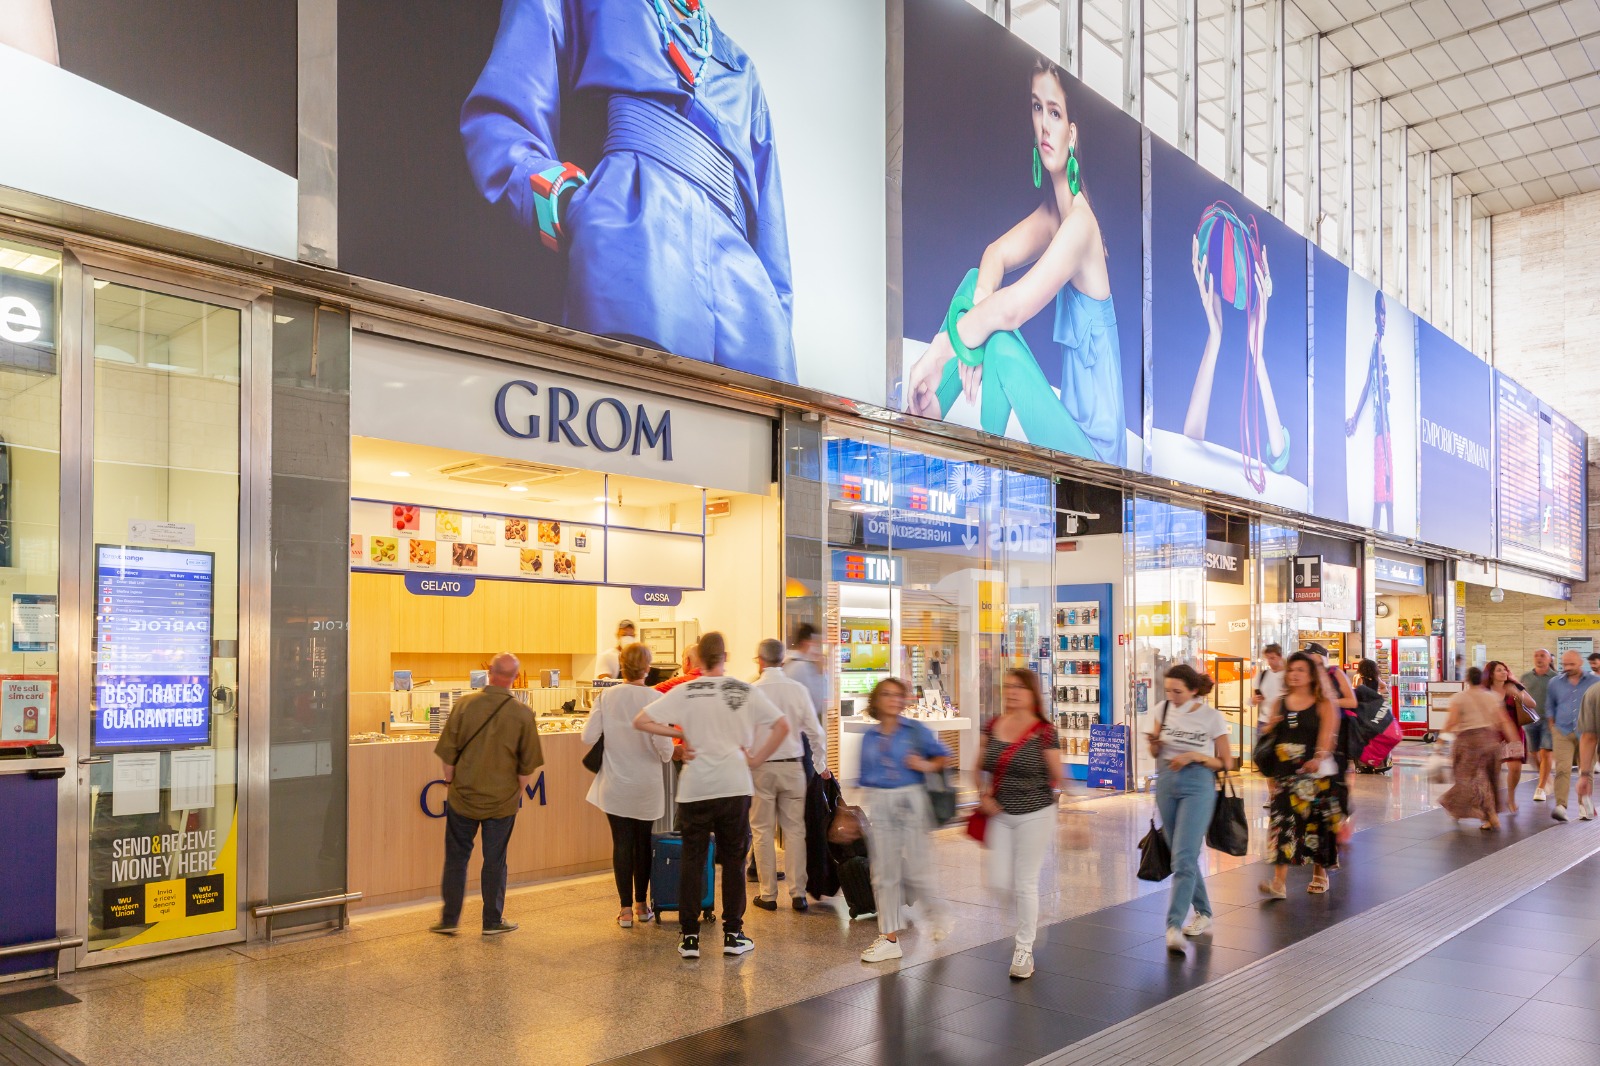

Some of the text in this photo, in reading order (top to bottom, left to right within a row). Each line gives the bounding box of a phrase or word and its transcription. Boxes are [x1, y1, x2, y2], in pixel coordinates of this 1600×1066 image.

[494, 379, 674, 462] GROM
[1422, 417, 1456, 455] EMPORIO
[862, 477, 894, 505] TIM
[928, 489, 957, 515] TIM
[865, 557, 896, 581] TIM
[1297, 557, 1319, 587] T
[420, 580, 461, 592] GELATO
[644, 592, 670, 602] CASSA
[105, 683, 203, 704] BEST RATES
[103, 708, 204, 729] GUARANTEED
[420, 770, 547, 819] GM
[111, 850, 217, 883] MONEY HERE
[157, 888, 173, 896] Invia
[159, 894, 177, 902] ricevi
[191, 890, 219, 900] Western
[198, 885, 212, 893] WU
[110, 902, 139, 912] Western
[118, 896, 132, 904] WU
